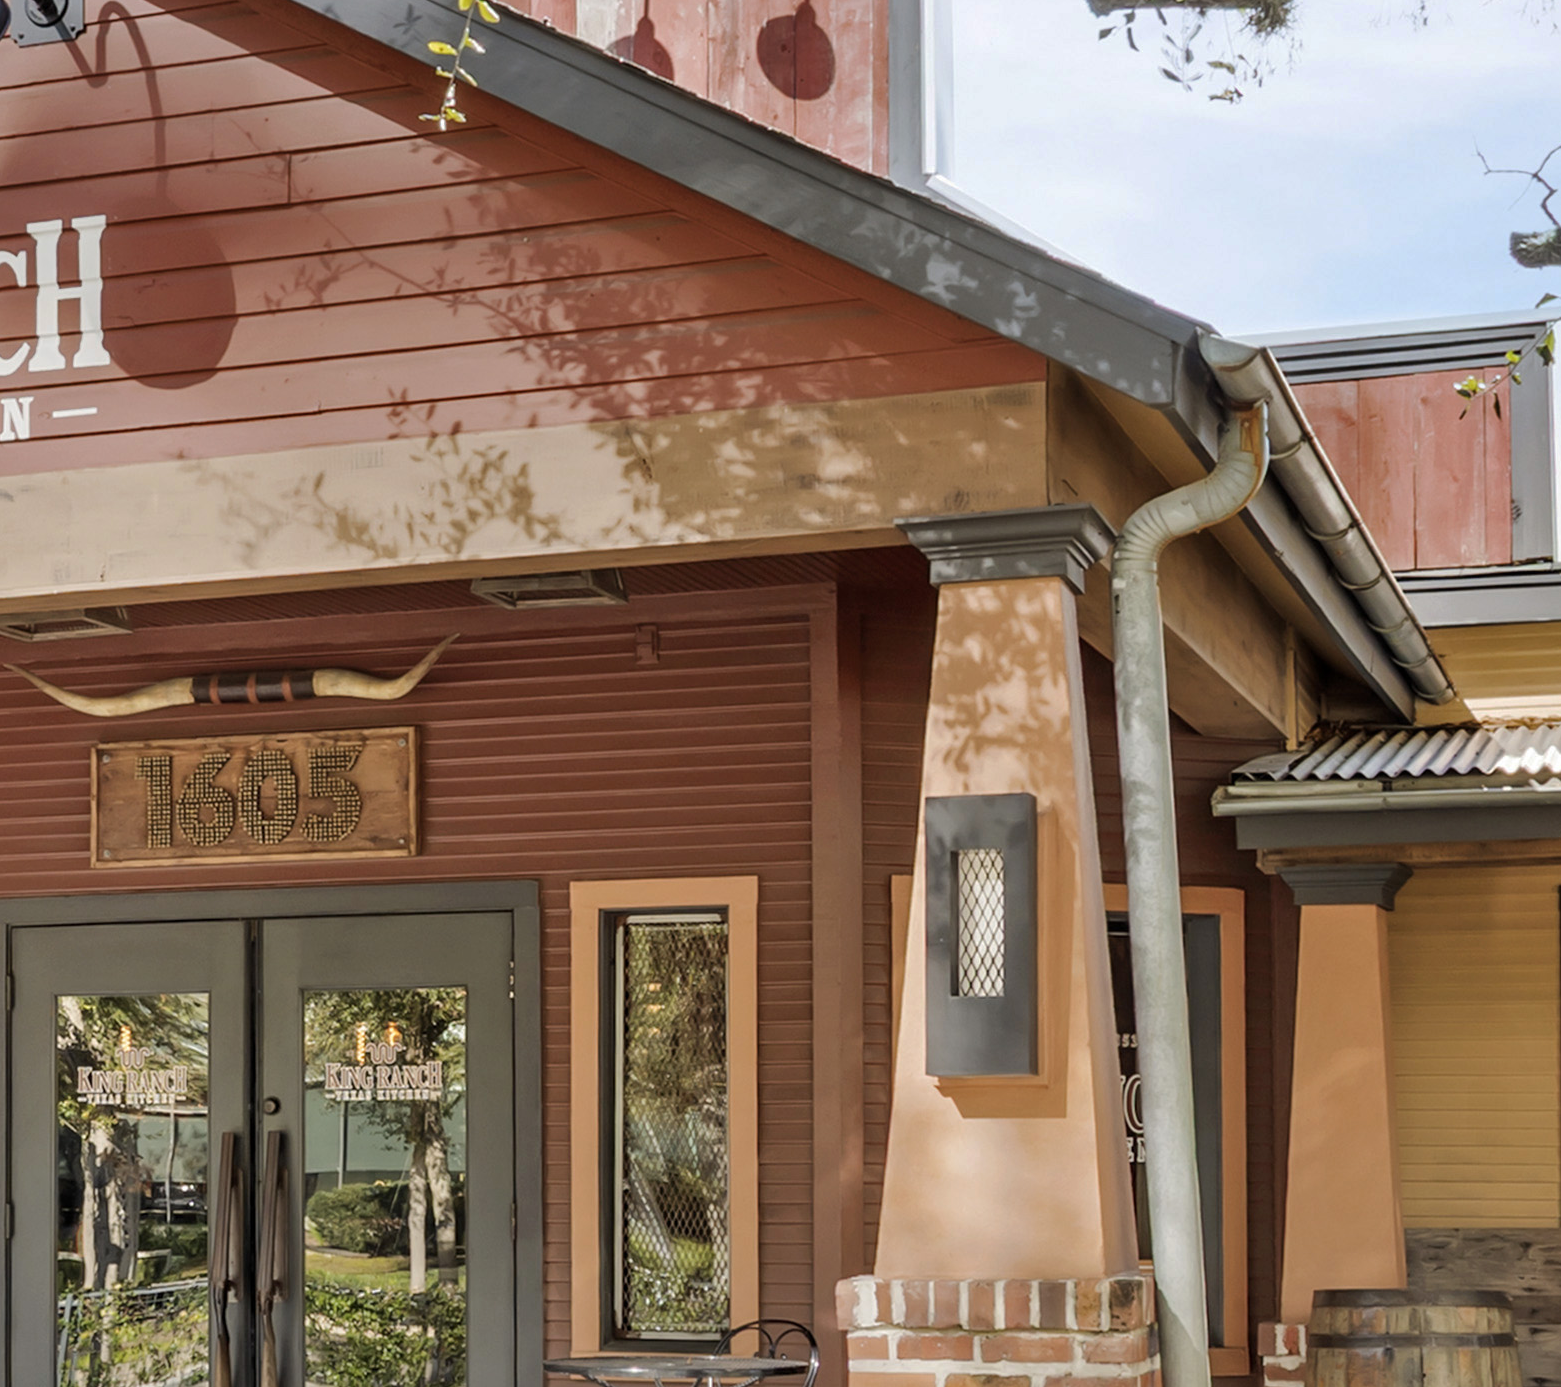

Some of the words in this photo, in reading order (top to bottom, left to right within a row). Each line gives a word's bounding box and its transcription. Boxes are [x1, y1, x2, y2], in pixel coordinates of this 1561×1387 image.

[134, 742, 365, 849] 1605
[77, 1066, 125, 1094] KING
[126, 1065, 188, 1093] RANCH
[324, 1062, 374, 1090] KING
[376, 1061, 442, 1089] RANCH
